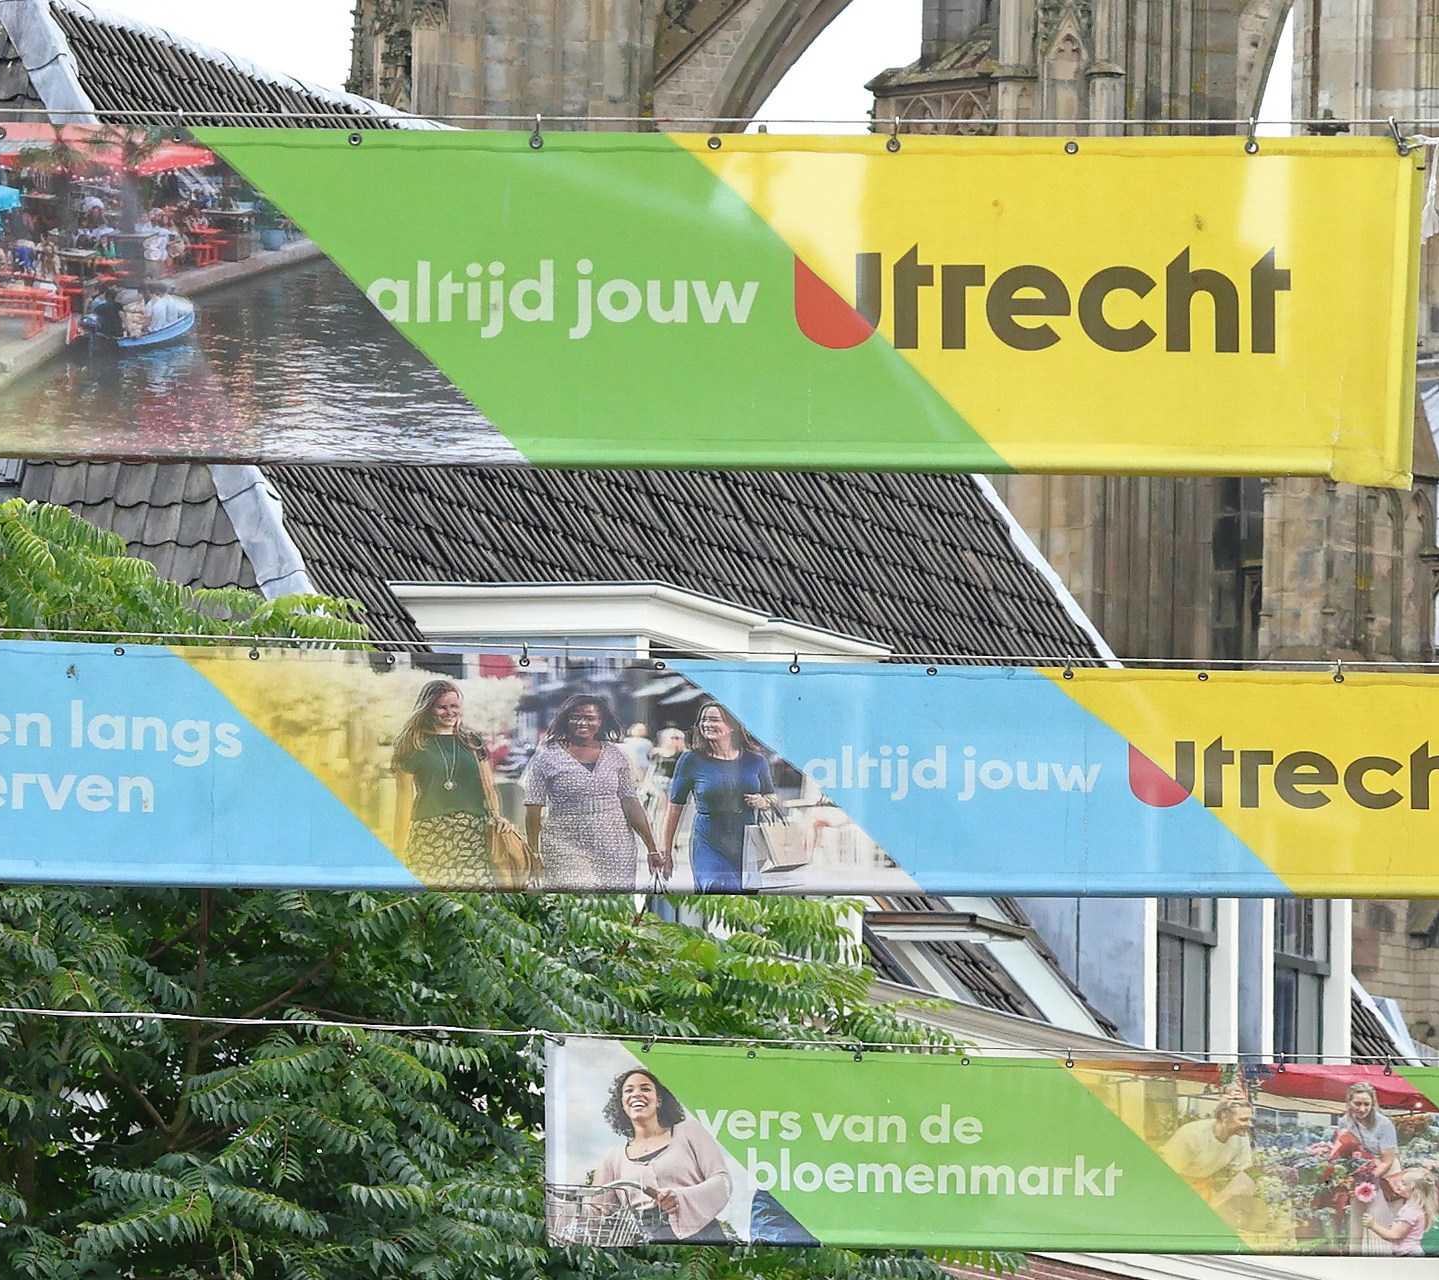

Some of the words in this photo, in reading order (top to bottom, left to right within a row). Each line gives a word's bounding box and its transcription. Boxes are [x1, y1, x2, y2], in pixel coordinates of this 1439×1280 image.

[367, 258, 557, 341] altijd
[565, 257, 760, 341] jouw
[793, 243, 1292, 354] Utrecht
[70, 698, 243, 770] langs
[803, 744, 948, 802] altijd
[955, 746, 1101, 803] jouw
[695, 1109, 801, 1146] vers
[814, 1112, 907, 1144] van
[920, 1103, 984, 1144] de
[747, 1153, 1123, 1197] bloemenmarkt
